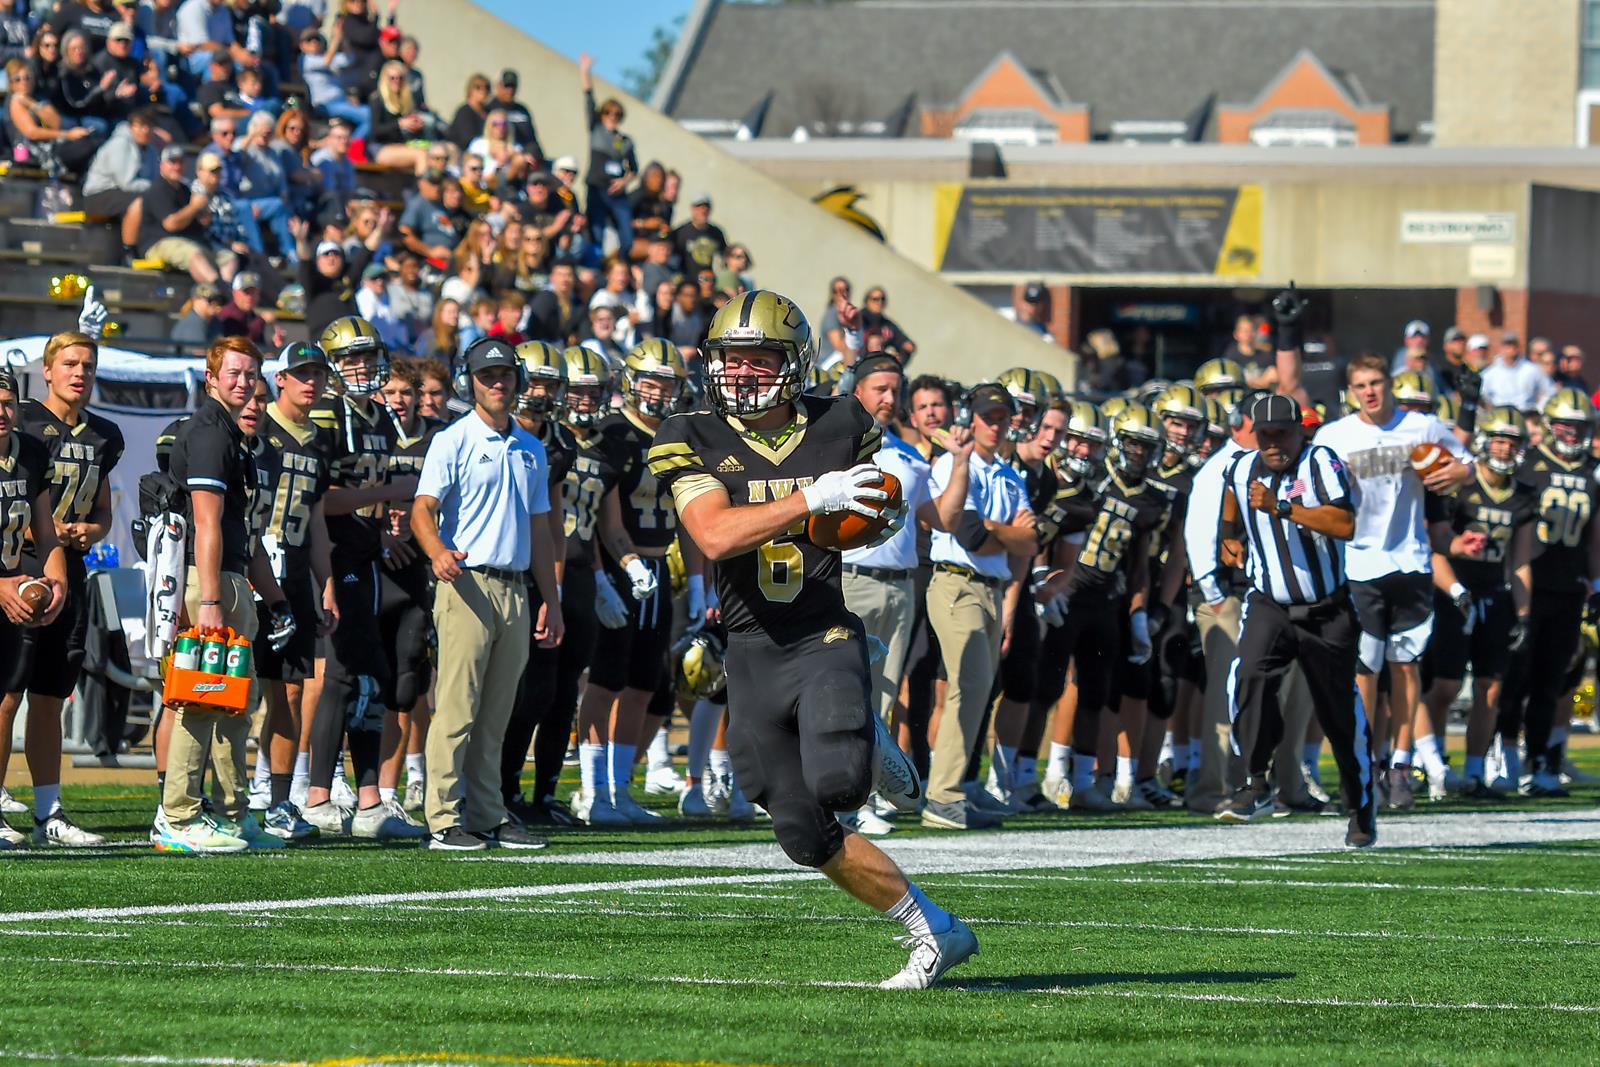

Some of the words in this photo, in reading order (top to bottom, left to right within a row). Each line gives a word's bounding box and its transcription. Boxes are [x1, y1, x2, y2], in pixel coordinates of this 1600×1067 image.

[0, 479, 27, 498] WU
[51, 460, 100, 522] 74
[716, 464, 745, 473] adidas
[0, 499, 32, 571] 0
[265, 471, 316, 547] 15
[1537, 486, 1591, 548] 90
[757, 518, 805, 603] 6
[204, 647, 219, 665] G
[226, 650, 240, 668] G
